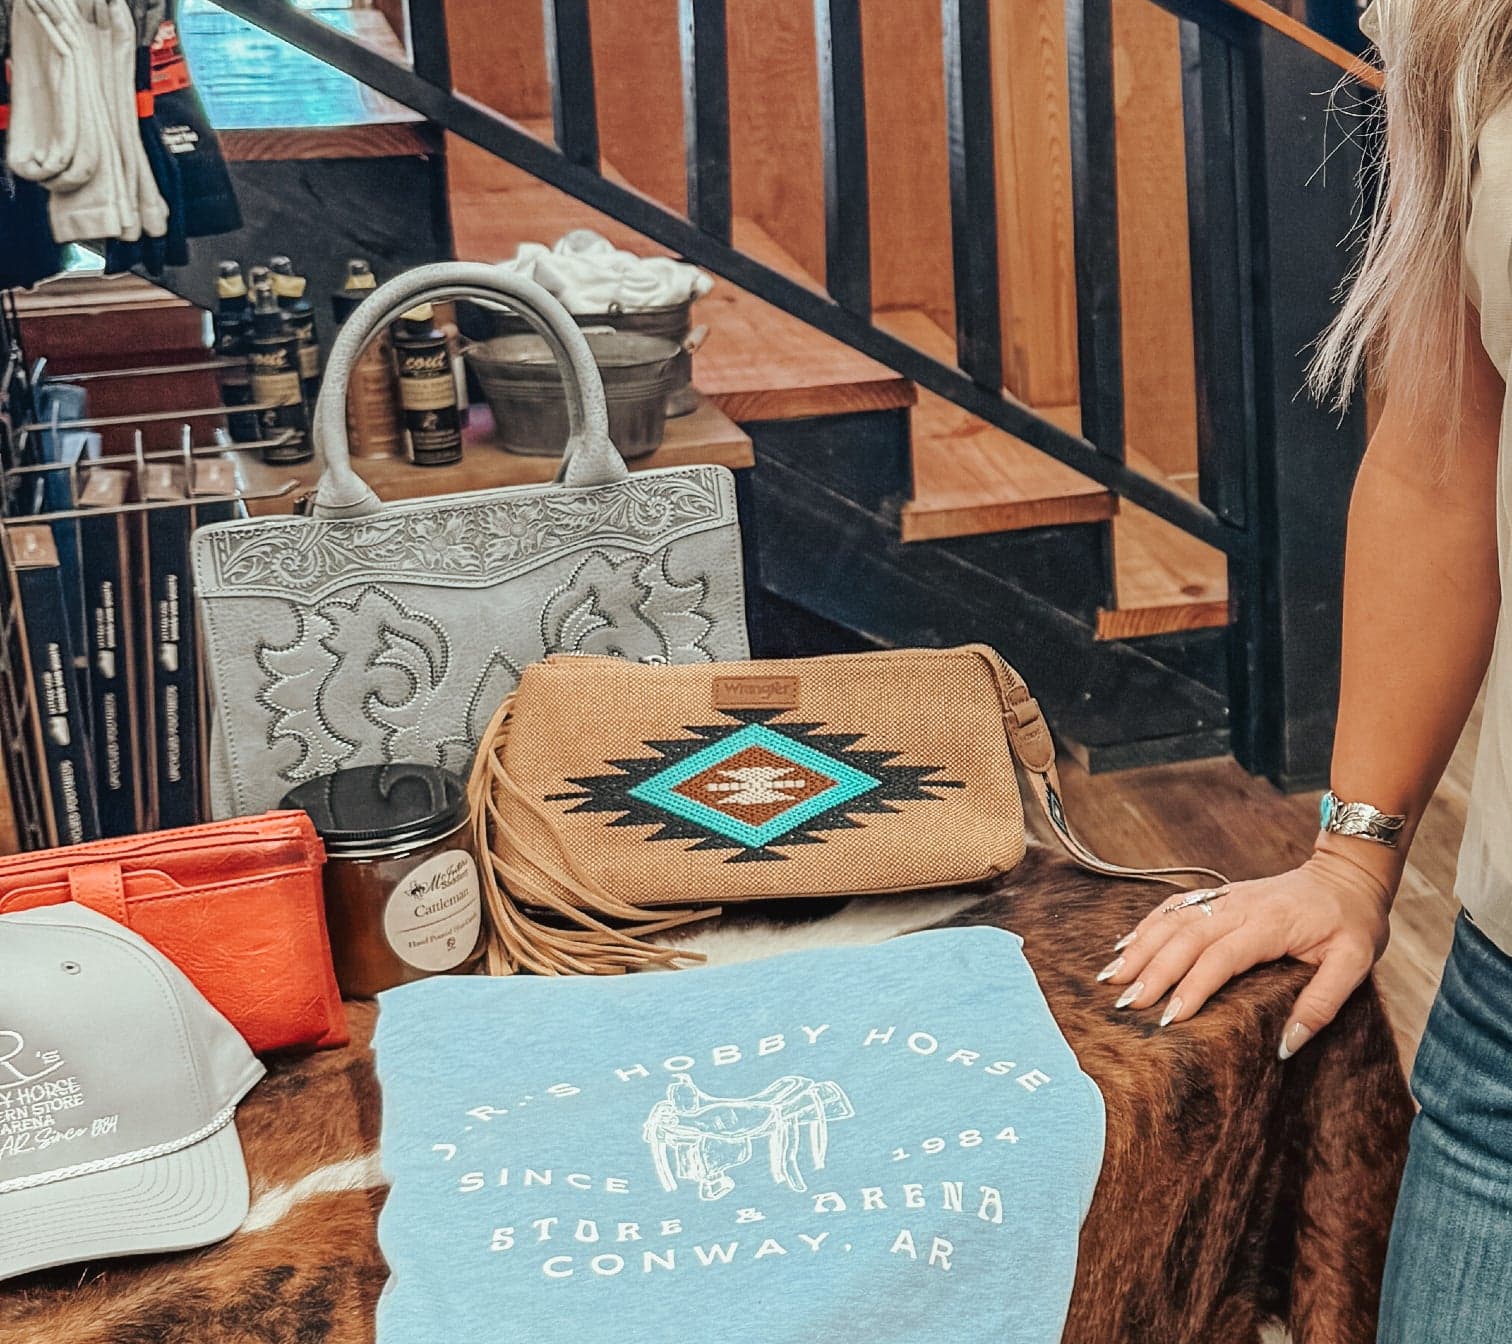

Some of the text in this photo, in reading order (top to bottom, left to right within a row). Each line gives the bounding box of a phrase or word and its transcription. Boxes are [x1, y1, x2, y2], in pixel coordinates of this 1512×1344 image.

[724, 681, 790, 699] Wrangler
[414, 887, 470, 918] Cattleman
[613, 1024, 1053, 1093] HOBBY HORSE
[17, 1076, 82, 1106] HORSE
[31, 1093, 85, 1117] STORE
[458, 1126, 1021, 1195] SINCE 1984
[489, 1181, 1005, 1252] STORE & ARENA
[889, 1228, 956, 1272] AR
